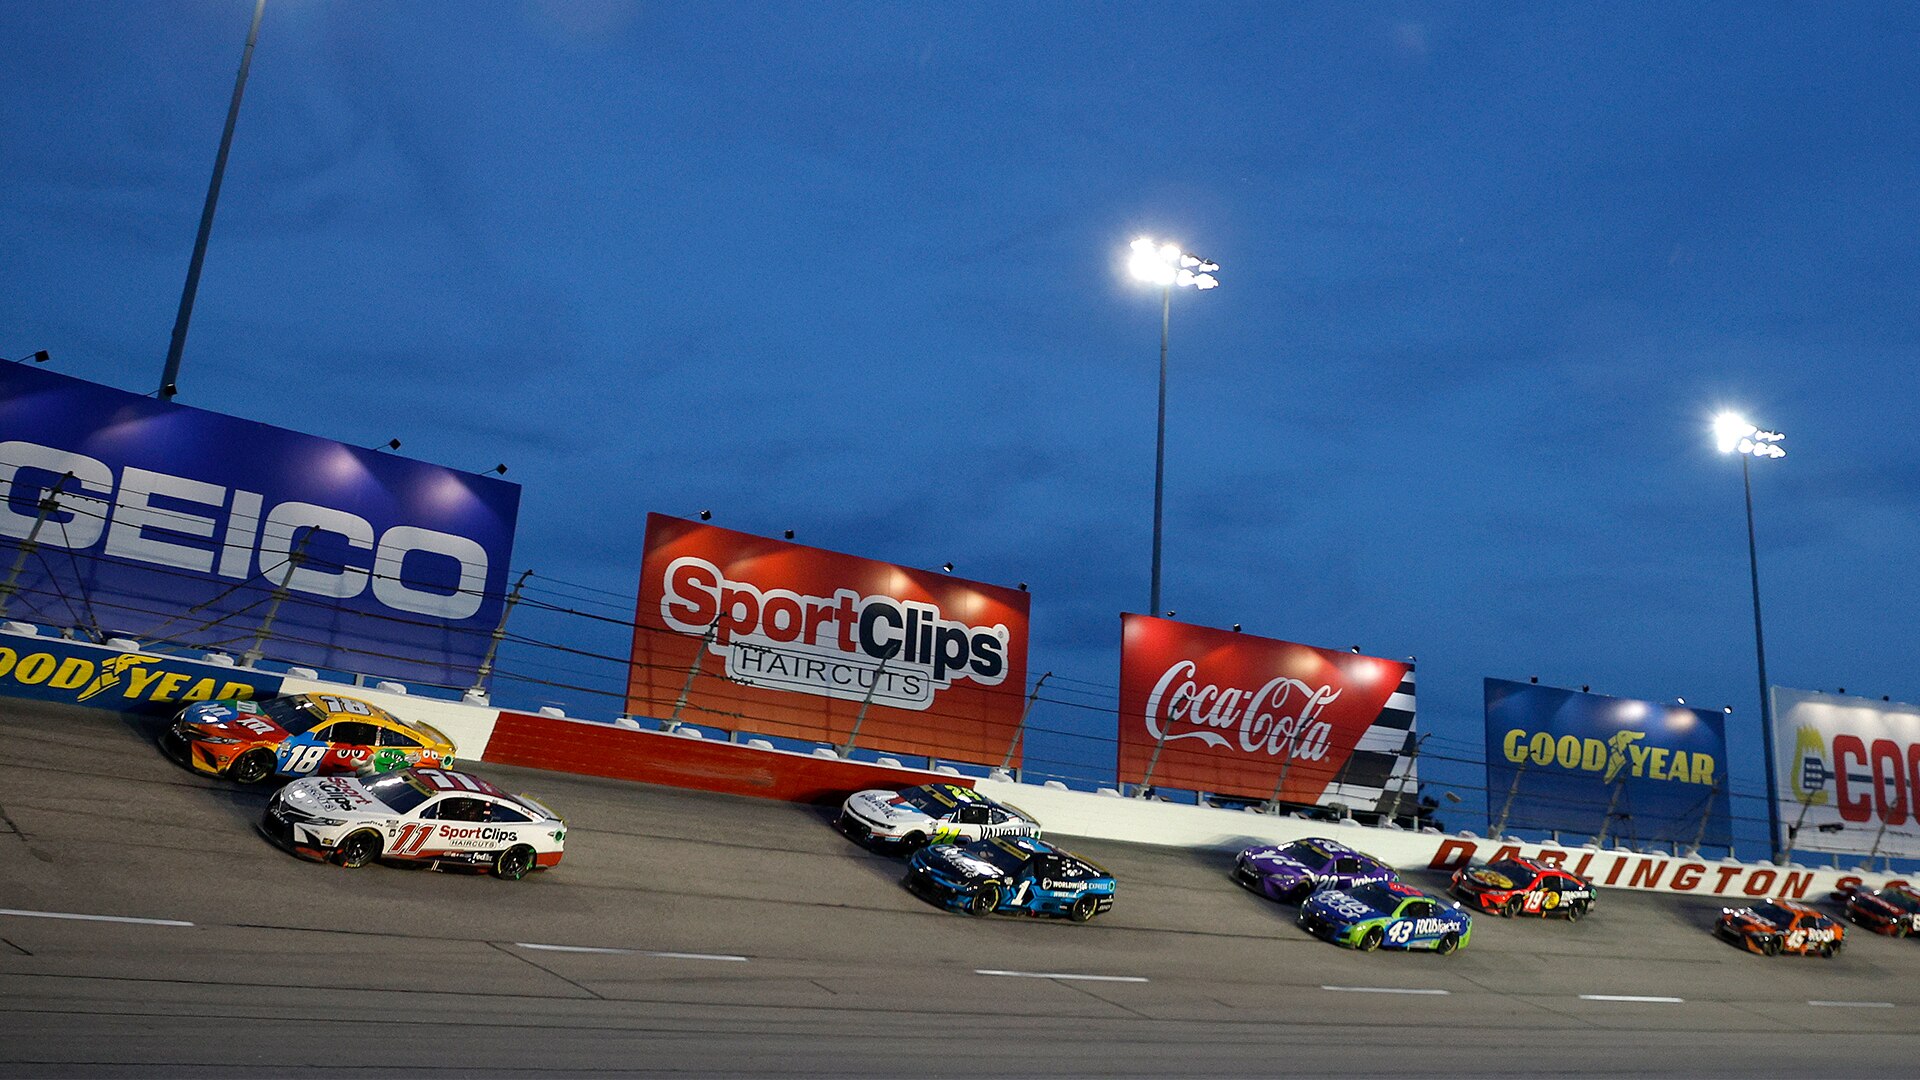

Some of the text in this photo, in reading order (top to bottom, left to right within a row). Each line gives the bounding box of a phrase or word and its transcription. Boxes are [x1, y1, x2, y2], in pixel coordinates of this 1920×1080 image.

[0, 440, 489, 620] GEICO
[741, 649, 921, 695] HAIRCUTS
[1145, 660, 1342, 762] Coca-Cola
[281, 745, 326, 774] 18
[389, 822, 437, 856] 11
[439, 825, 518, 843] SportClips
[451, 840, 495, 848] HAIRCUTS
[1011, 880, 1031, 906] 1
[1525, 890, 1545, 910] 19
[1388, 920, 1414, 944] 43
